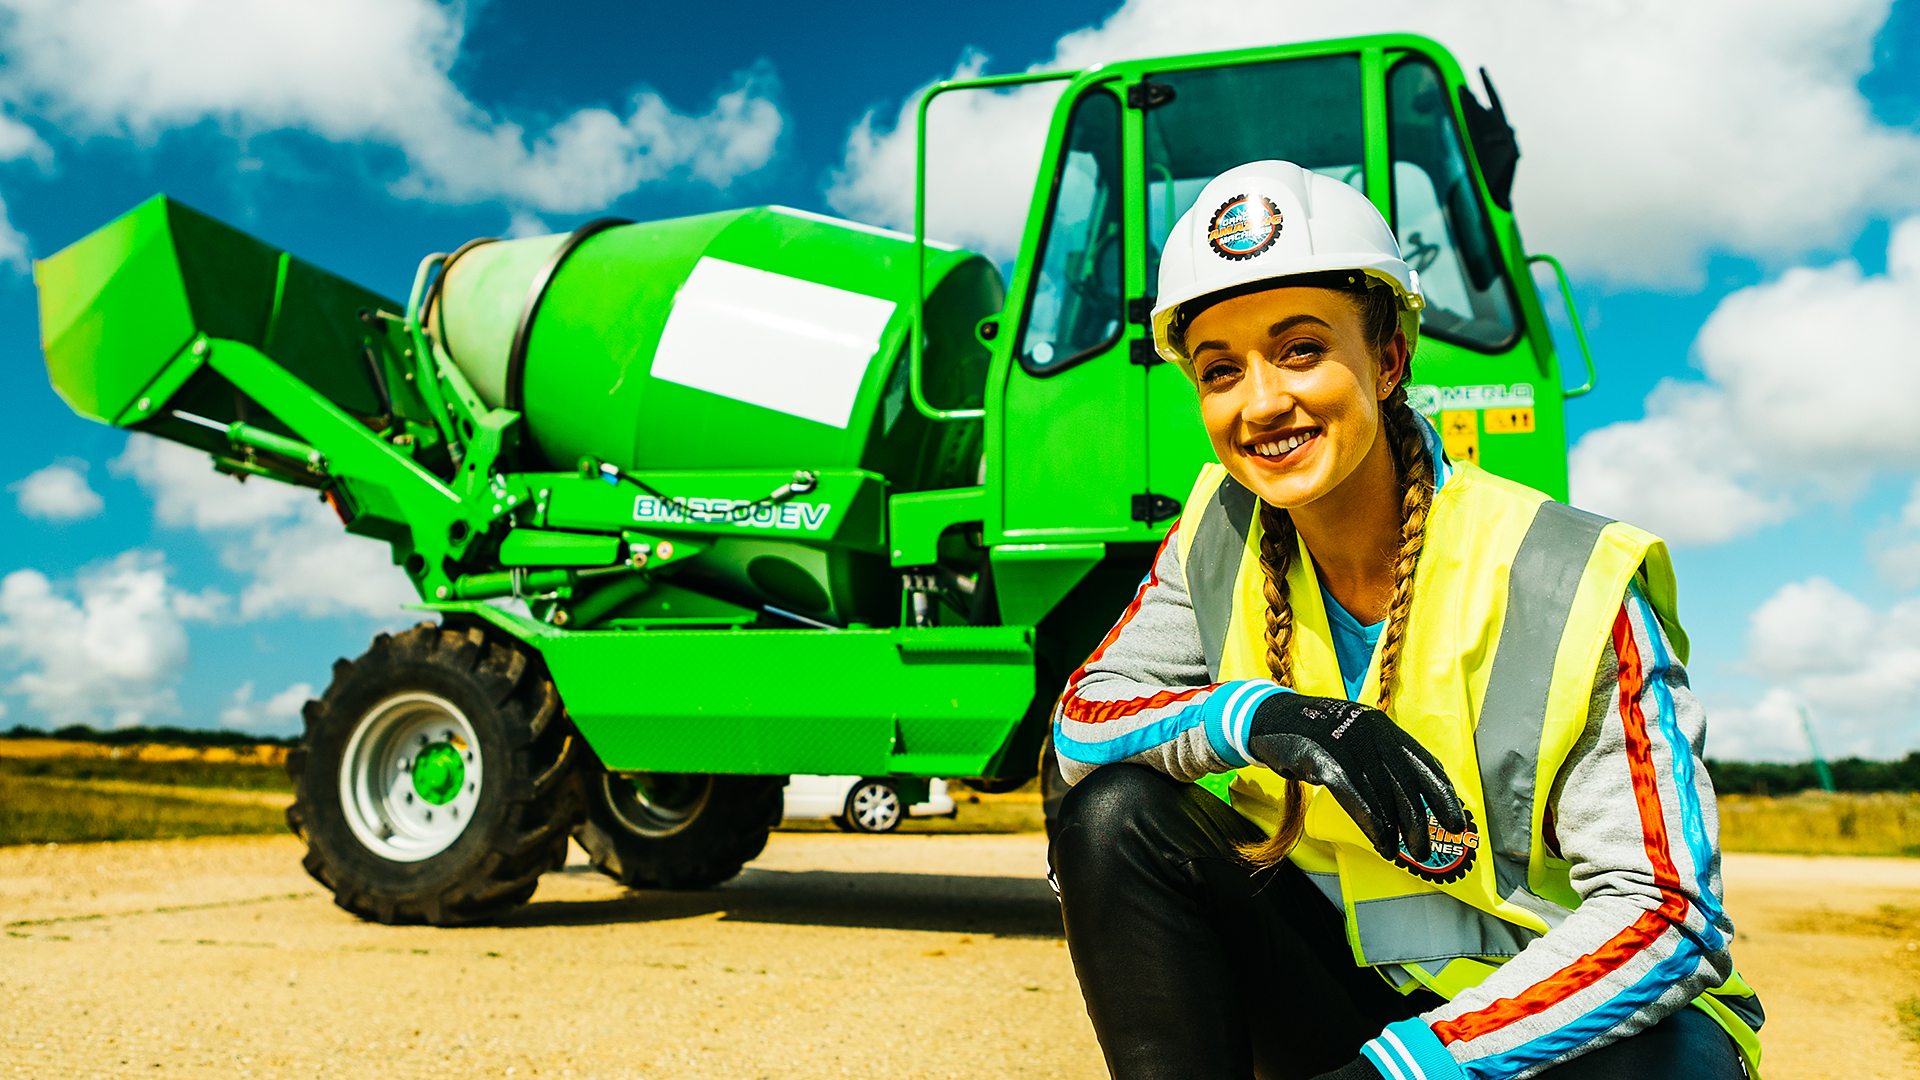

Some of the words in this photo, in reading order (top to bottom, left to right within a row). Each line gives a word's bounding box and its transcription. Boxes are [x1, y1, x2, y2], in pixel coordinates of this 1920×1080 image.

[1208, 214, 1282, 241] AMAZNG
[1441, 385, 1533, 402] MERLO
[1428, 825, 1478, 848] ZING
